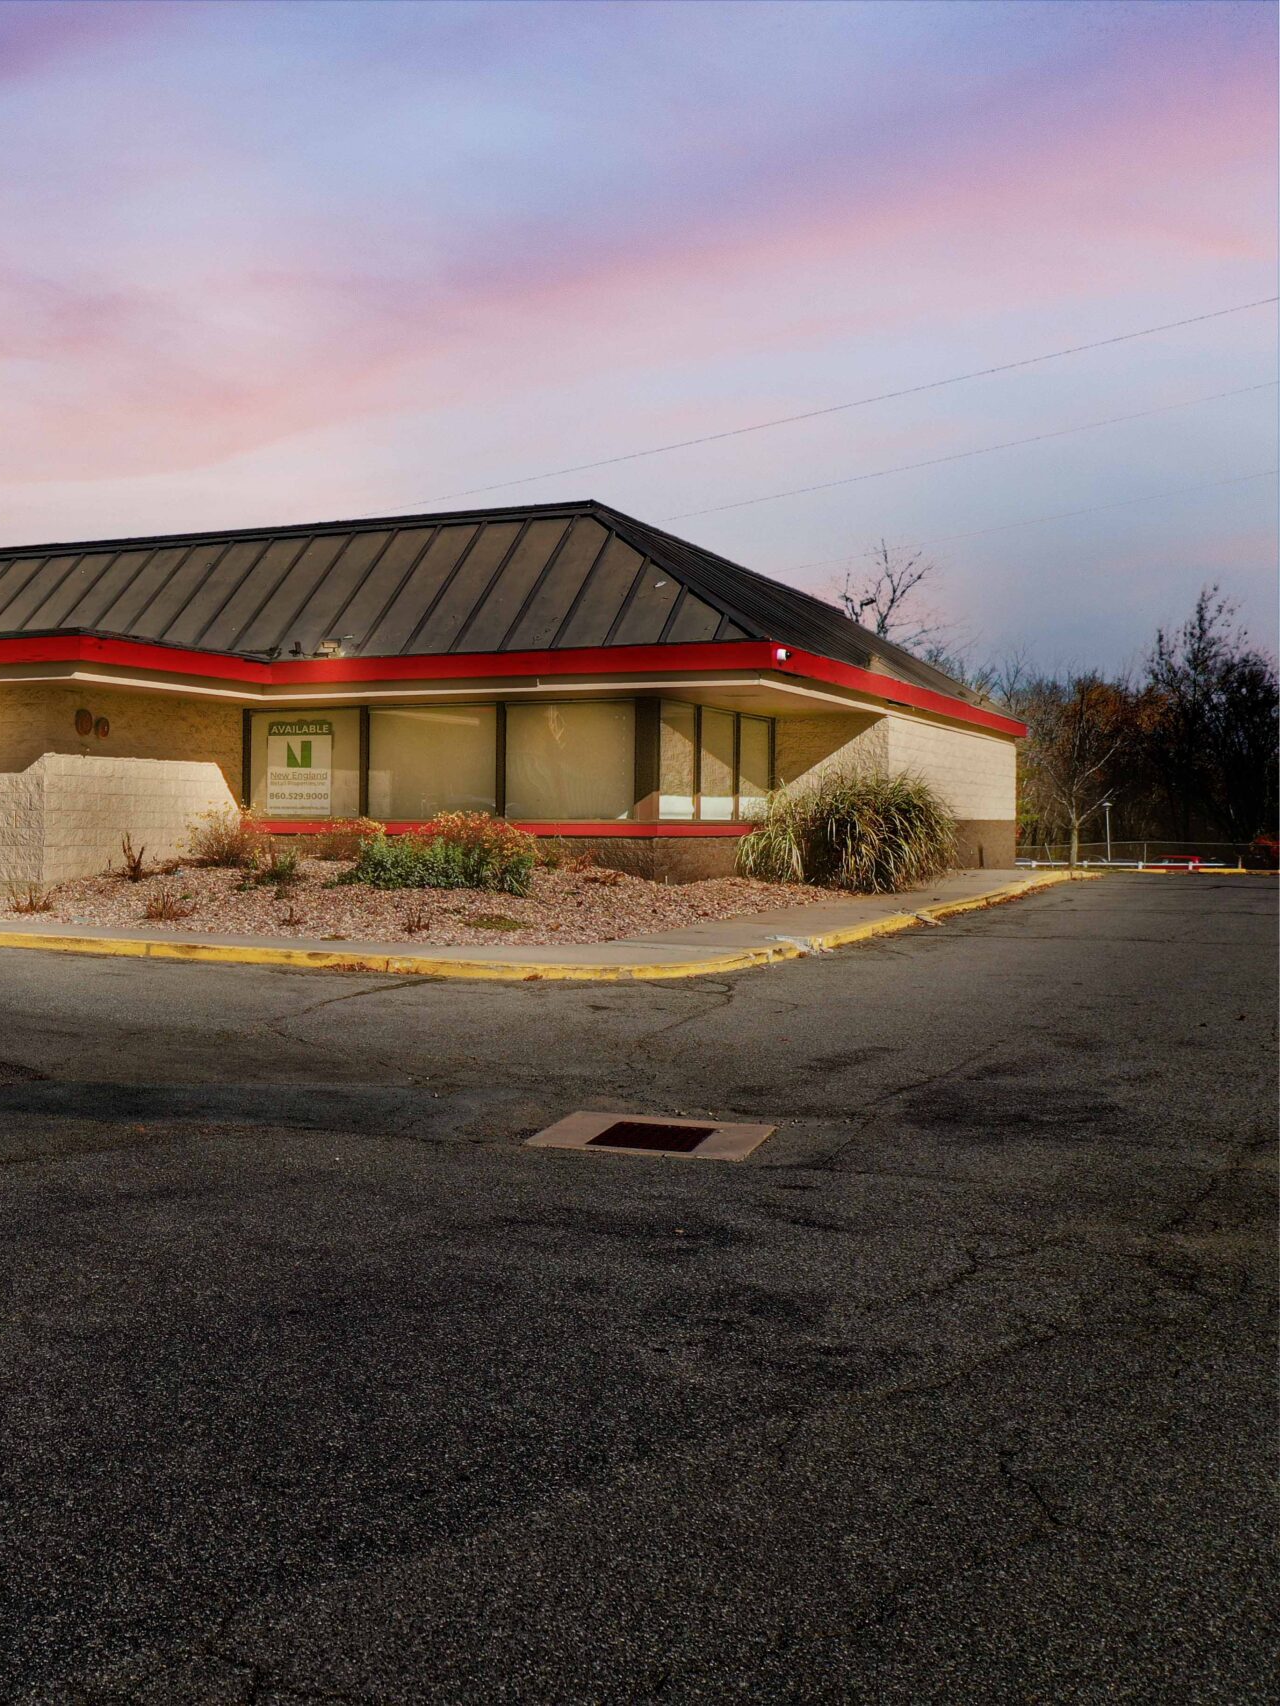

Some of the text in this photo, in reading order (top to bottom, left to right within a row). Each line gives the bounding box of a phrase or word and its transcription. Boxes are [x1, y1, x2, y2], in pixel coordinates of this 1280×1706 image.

[271, 724, 329, 734] AVAILABLE
[270, 771, 328, 781] New England
[269, 792, 329, 800] 860.529.9000
